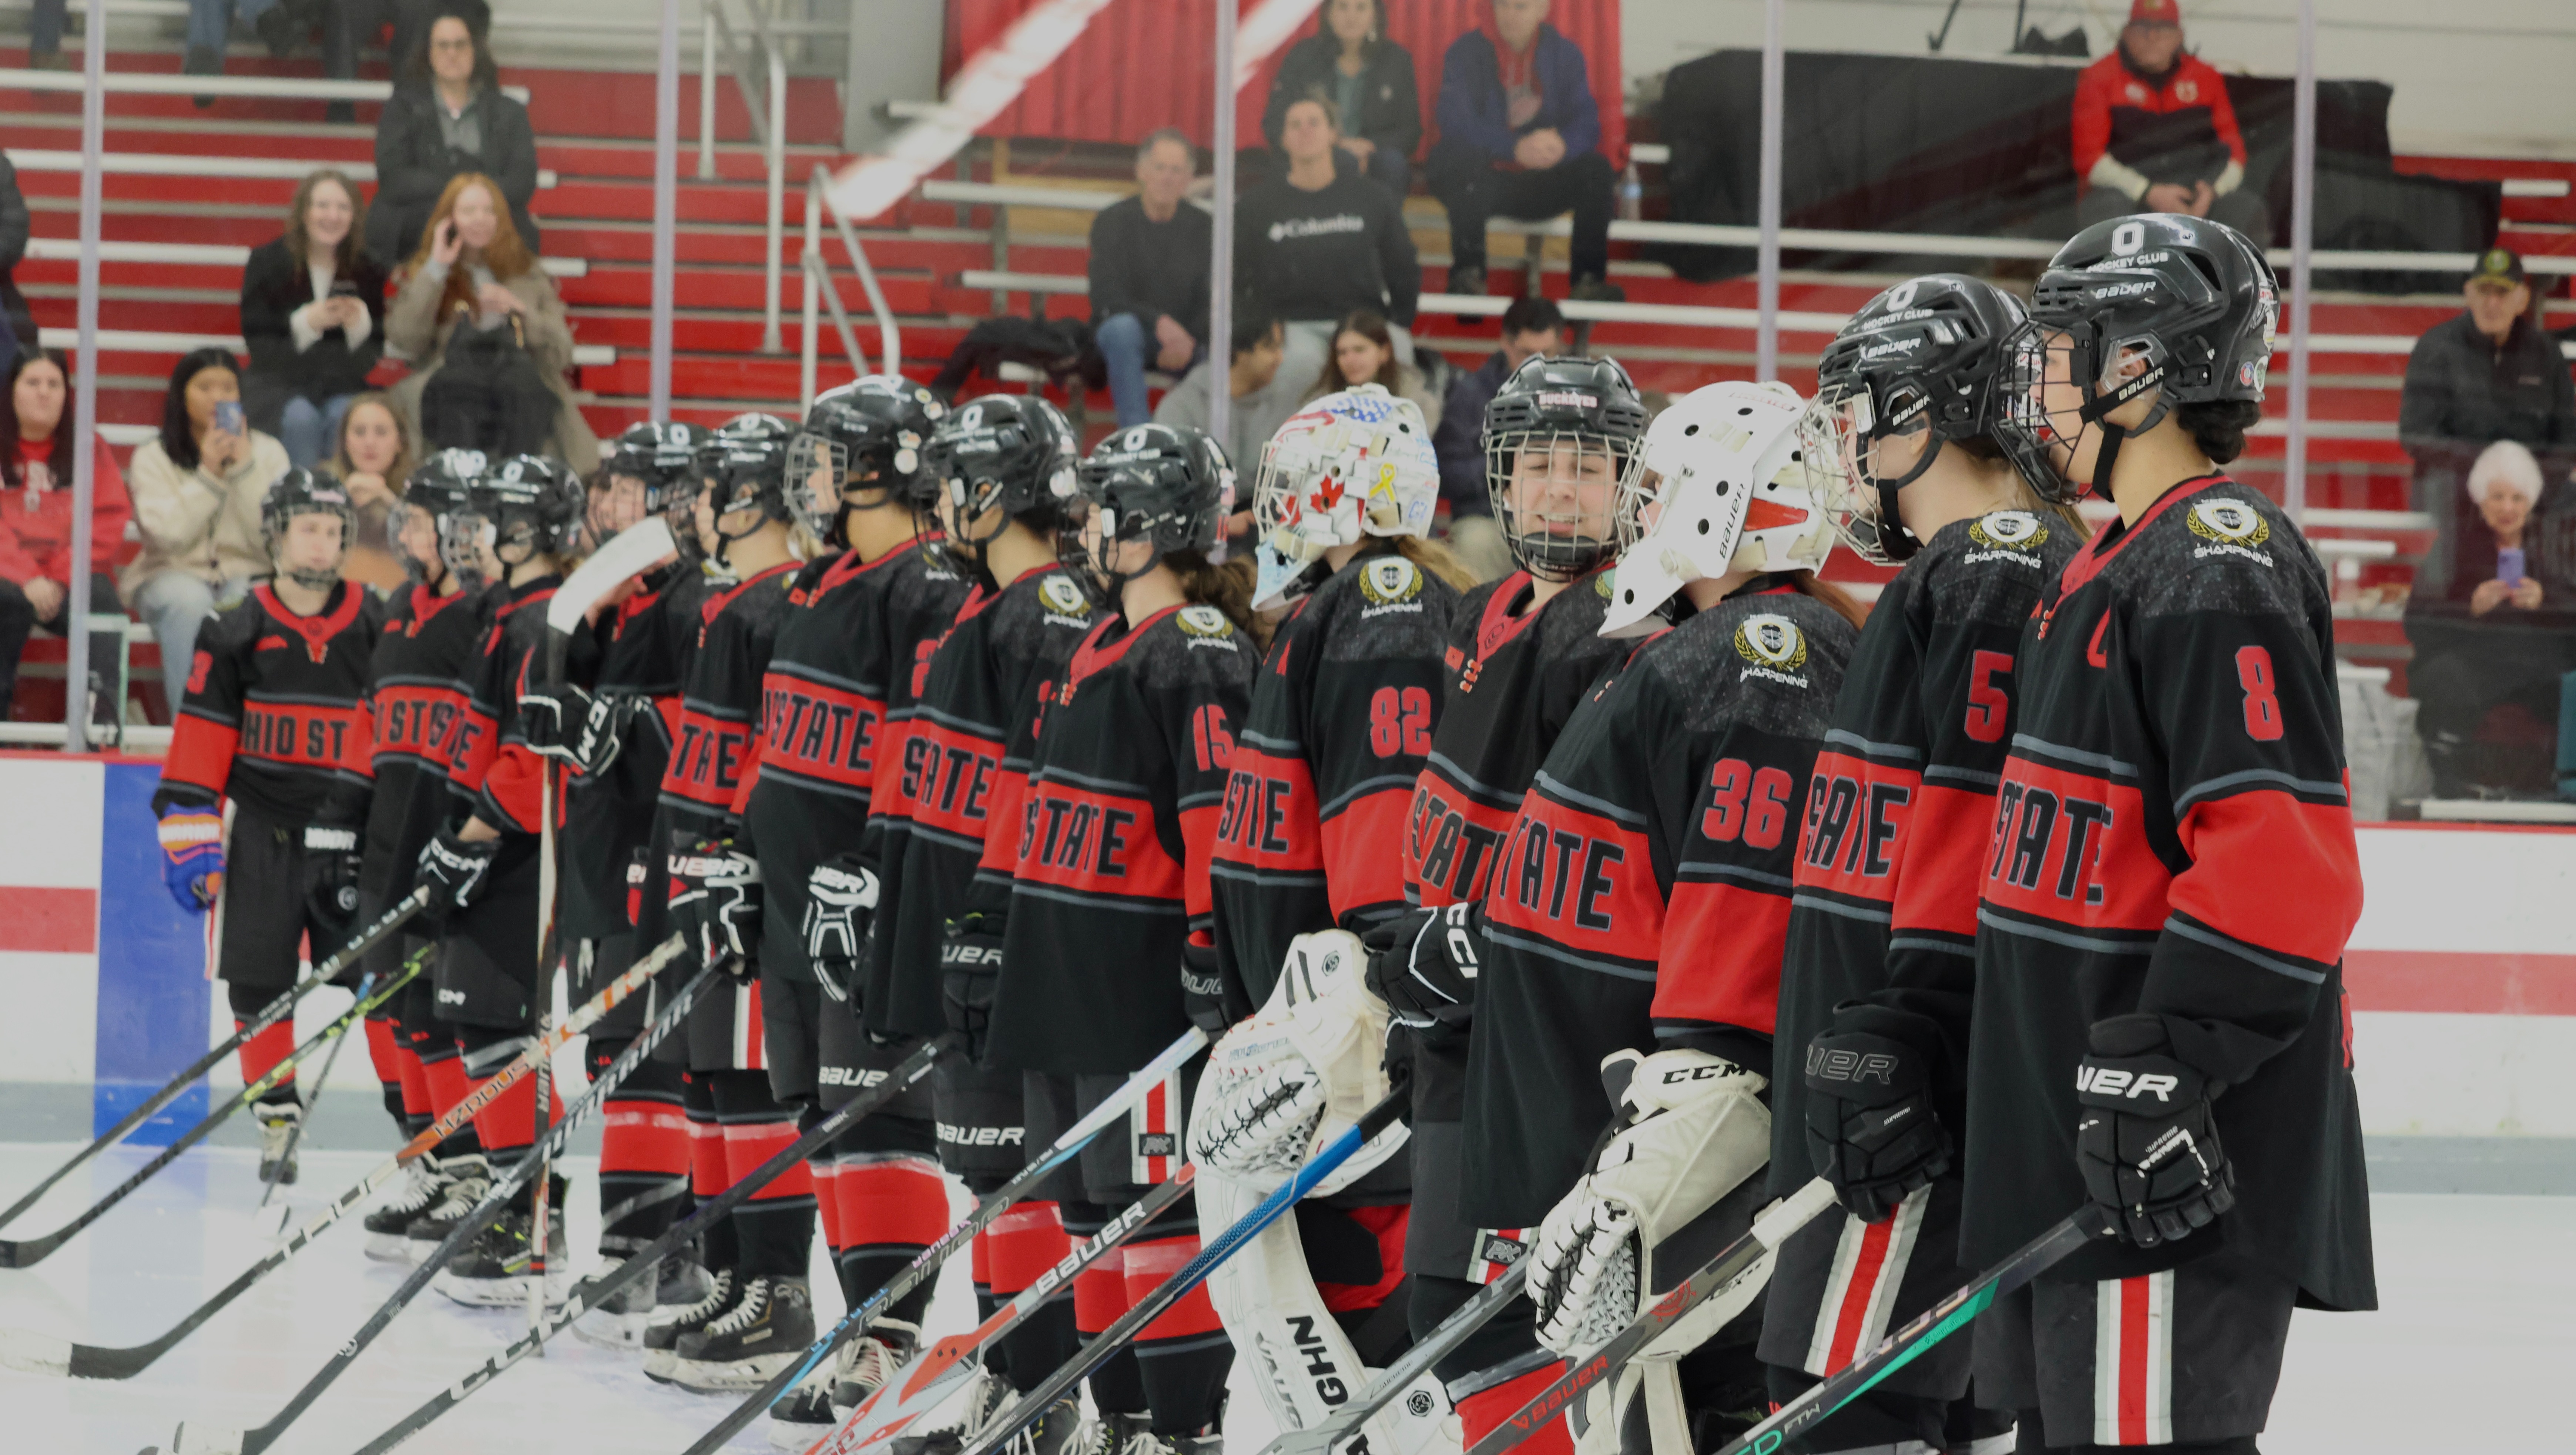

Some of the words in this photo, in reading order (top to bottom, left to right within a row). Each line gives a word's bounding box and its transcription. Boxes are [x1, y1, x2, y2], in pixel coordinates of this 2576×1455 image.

[1285, 212, 1364, 237] Columbia
[2111, 222, 2145, 256] O
[2087, 257, 2134, 273] HOCKEY
[2137, 252, 2169, 265] CLUB
[1886, 283, 1919, 312] O
[2095, 281, 2156, 299] BAUER
[1863, 311, 1903, 330] HOCKEY
[1904, 309, 1934, 319] CLUB
[1868, 338, 1921, 359] BAUER
[1539, 392, 1598, 408] BUCKEYES
[2118, 367, 2164, 401] BAUER
[1718, 483, 1747, 559] BAUER
[1964, 549, 2042, 569] SHARPENING
[2194, 544, 2273, 568] SHARPENING
[1740, 666, 1808, 689] SHARPENING
[2234, 645, 2284, 741] 8
[1964, 649, 2014, 743] 5
[1193, 704, 1236, 772] 15
[1370, 686, 1432, 759] 82
[1702, 757, 1794, 851] 36
[1662, 1063, 1748, 1085] CCM
[433, 1061, 531, 1141] HZRDUS
[1037, 1201, 1147, 1296] BAUER
[450, 1294, 584, 1401] CCM
[1527, 1354, 1610, 1425] BAUER
